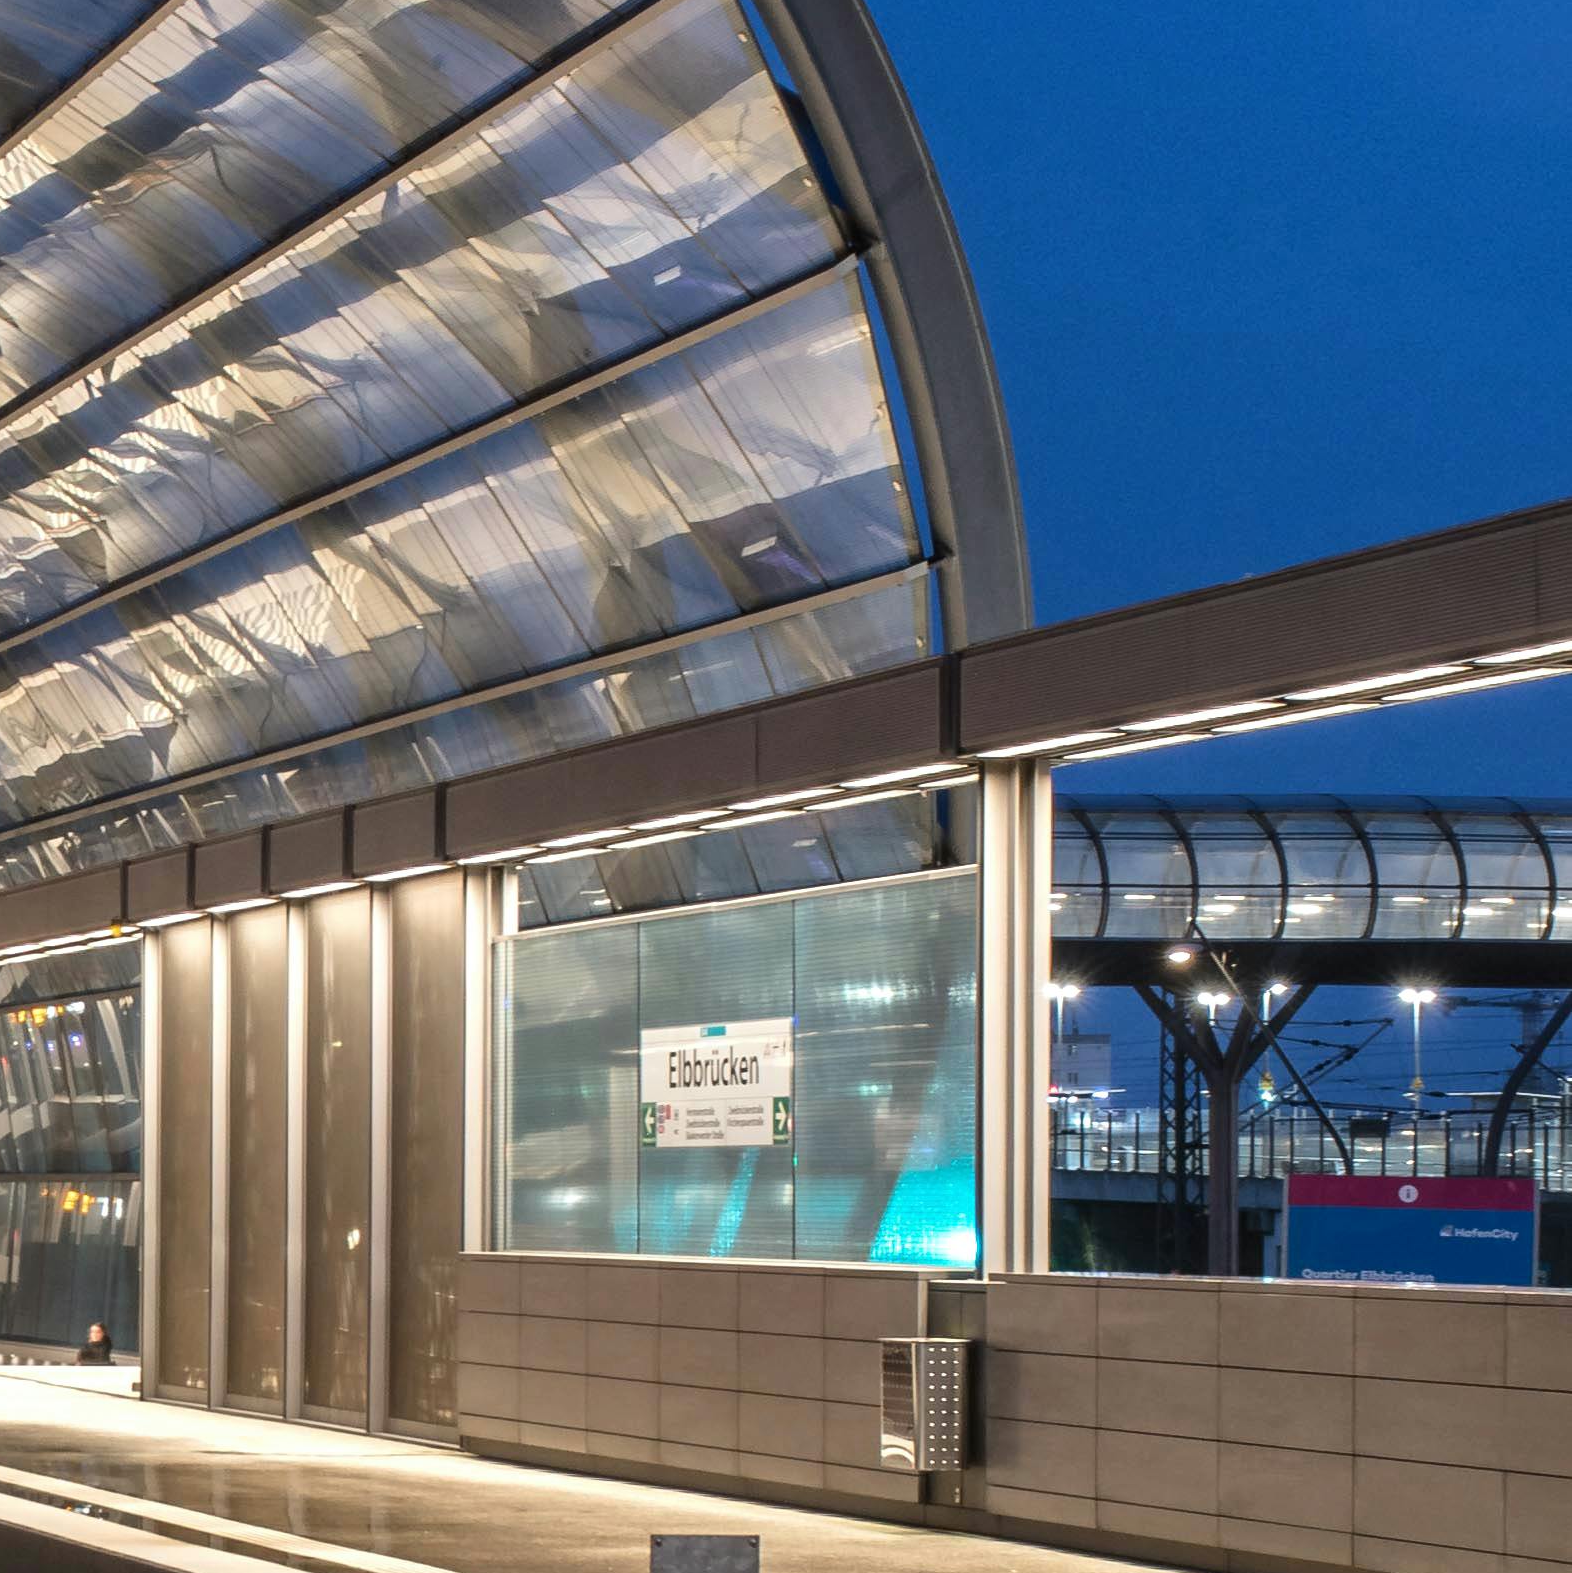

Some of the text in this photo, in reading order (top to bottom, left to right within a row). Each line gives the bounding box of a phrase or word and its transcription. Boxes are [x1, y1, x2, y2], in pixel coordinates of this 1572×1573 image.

[668, 1045, 760, 1089] Elbbrücken
[1454, 1228, 1519, 1241] HafenCity
[1302, 1268, 1435, 1283] Quartier Elbbrücken
